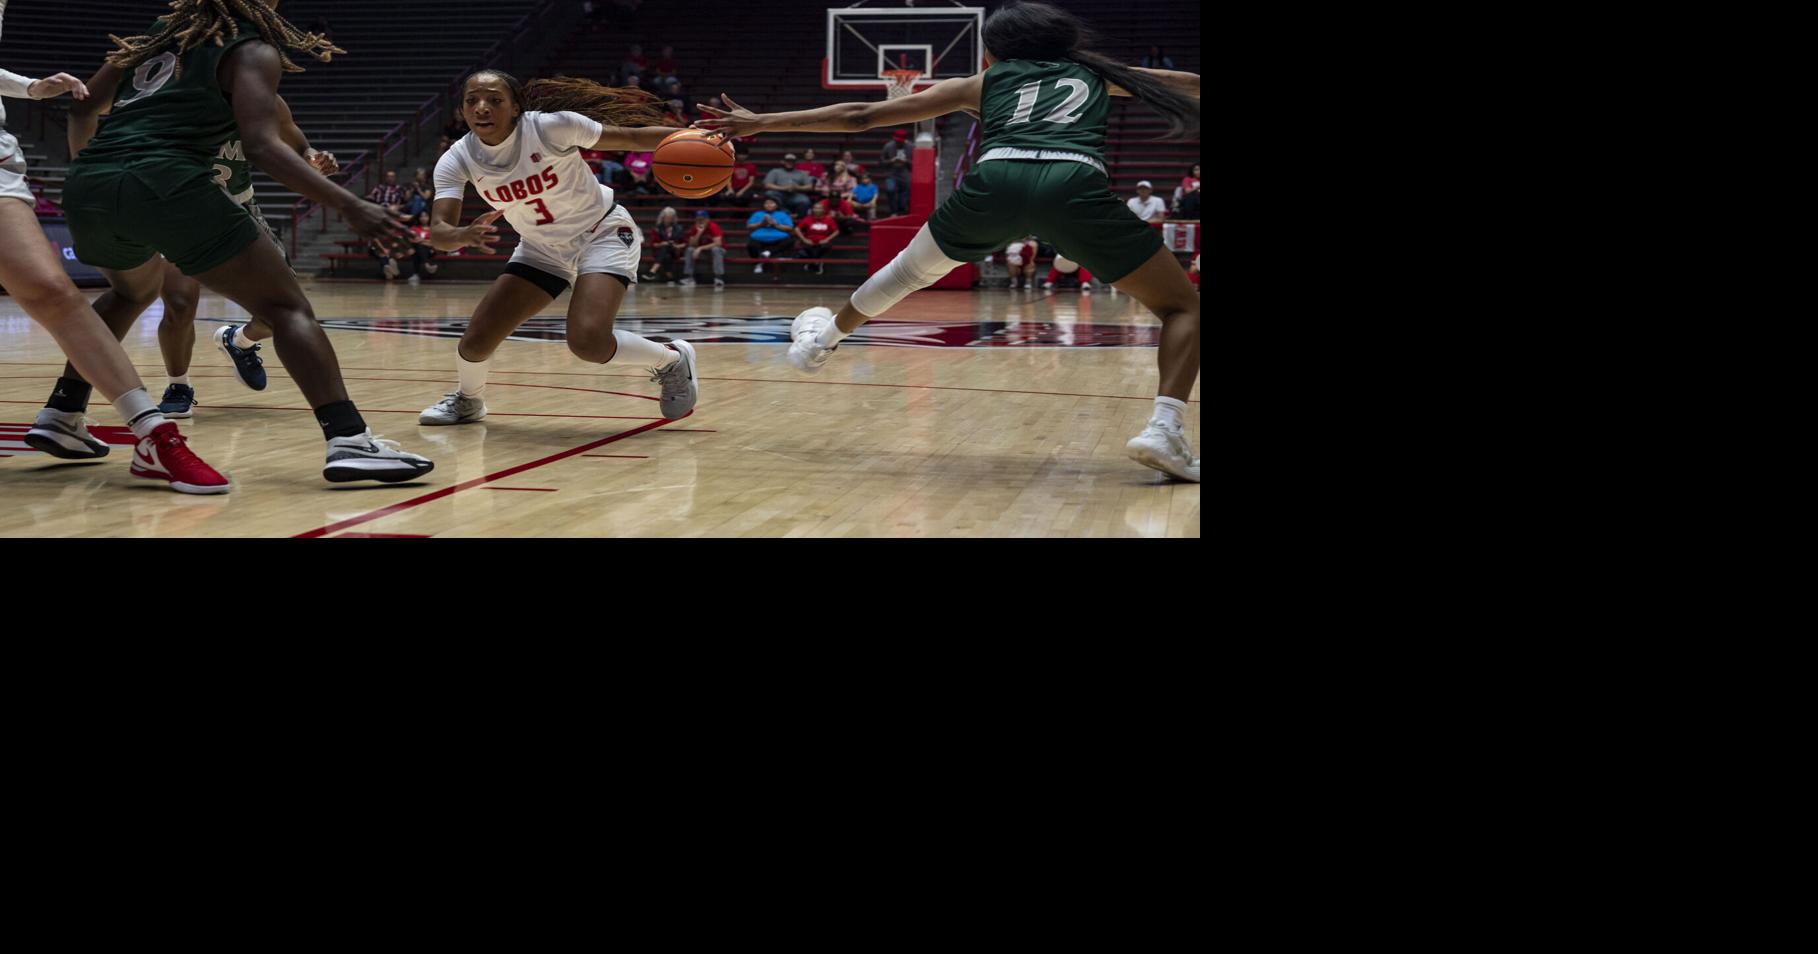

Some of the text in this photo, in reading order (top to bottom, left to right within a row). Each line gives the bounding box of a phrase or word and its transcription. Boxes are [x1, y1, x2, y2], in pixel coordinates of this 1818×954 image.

[114, 51, 176, 107] 9
[1005, 78, 1090, 125] 12
[483, 165, 559, 202] LOBOS
[525, 198, 554, 226] 3
